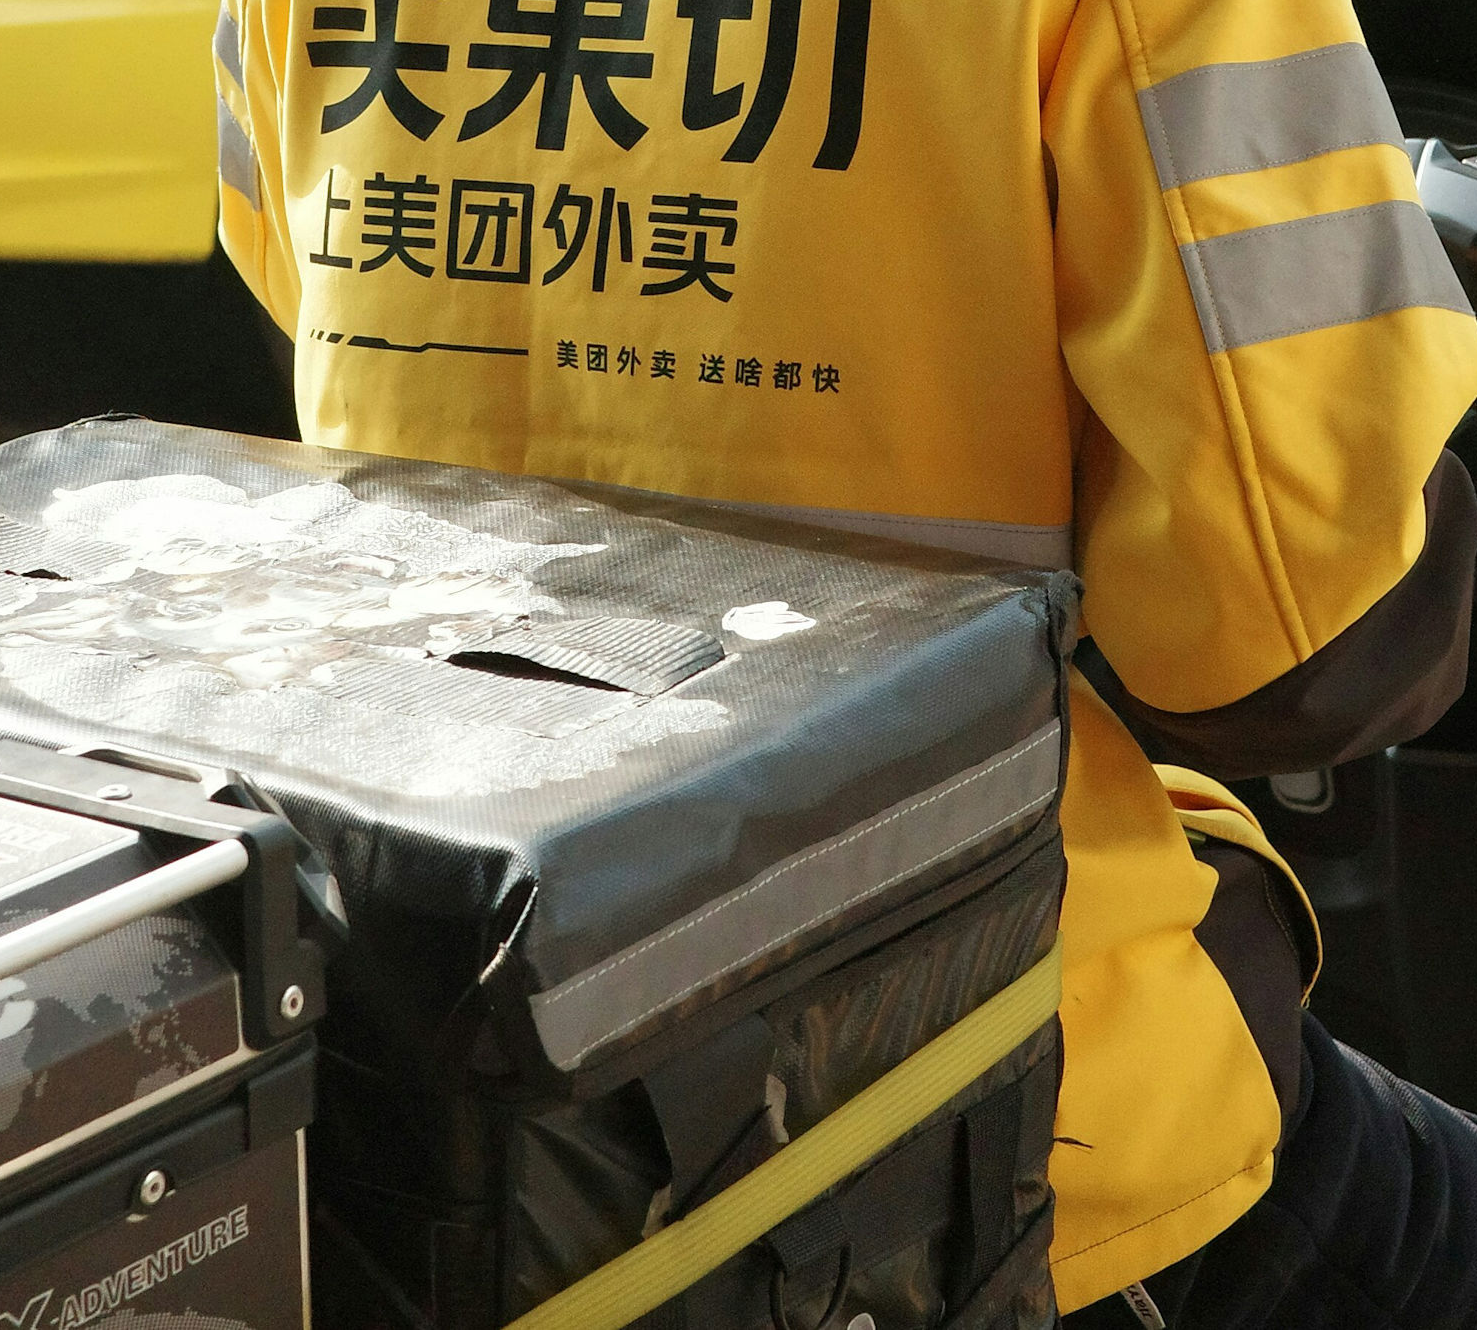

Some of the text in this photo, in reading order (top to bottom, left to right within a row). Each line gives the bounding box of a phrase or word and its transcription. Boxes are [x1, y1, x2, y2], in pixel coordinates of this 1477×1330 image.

[308, 169, 740, 304] 上美团外卖
[555, 338, 841, 394] 美团外卖 送啥都快
